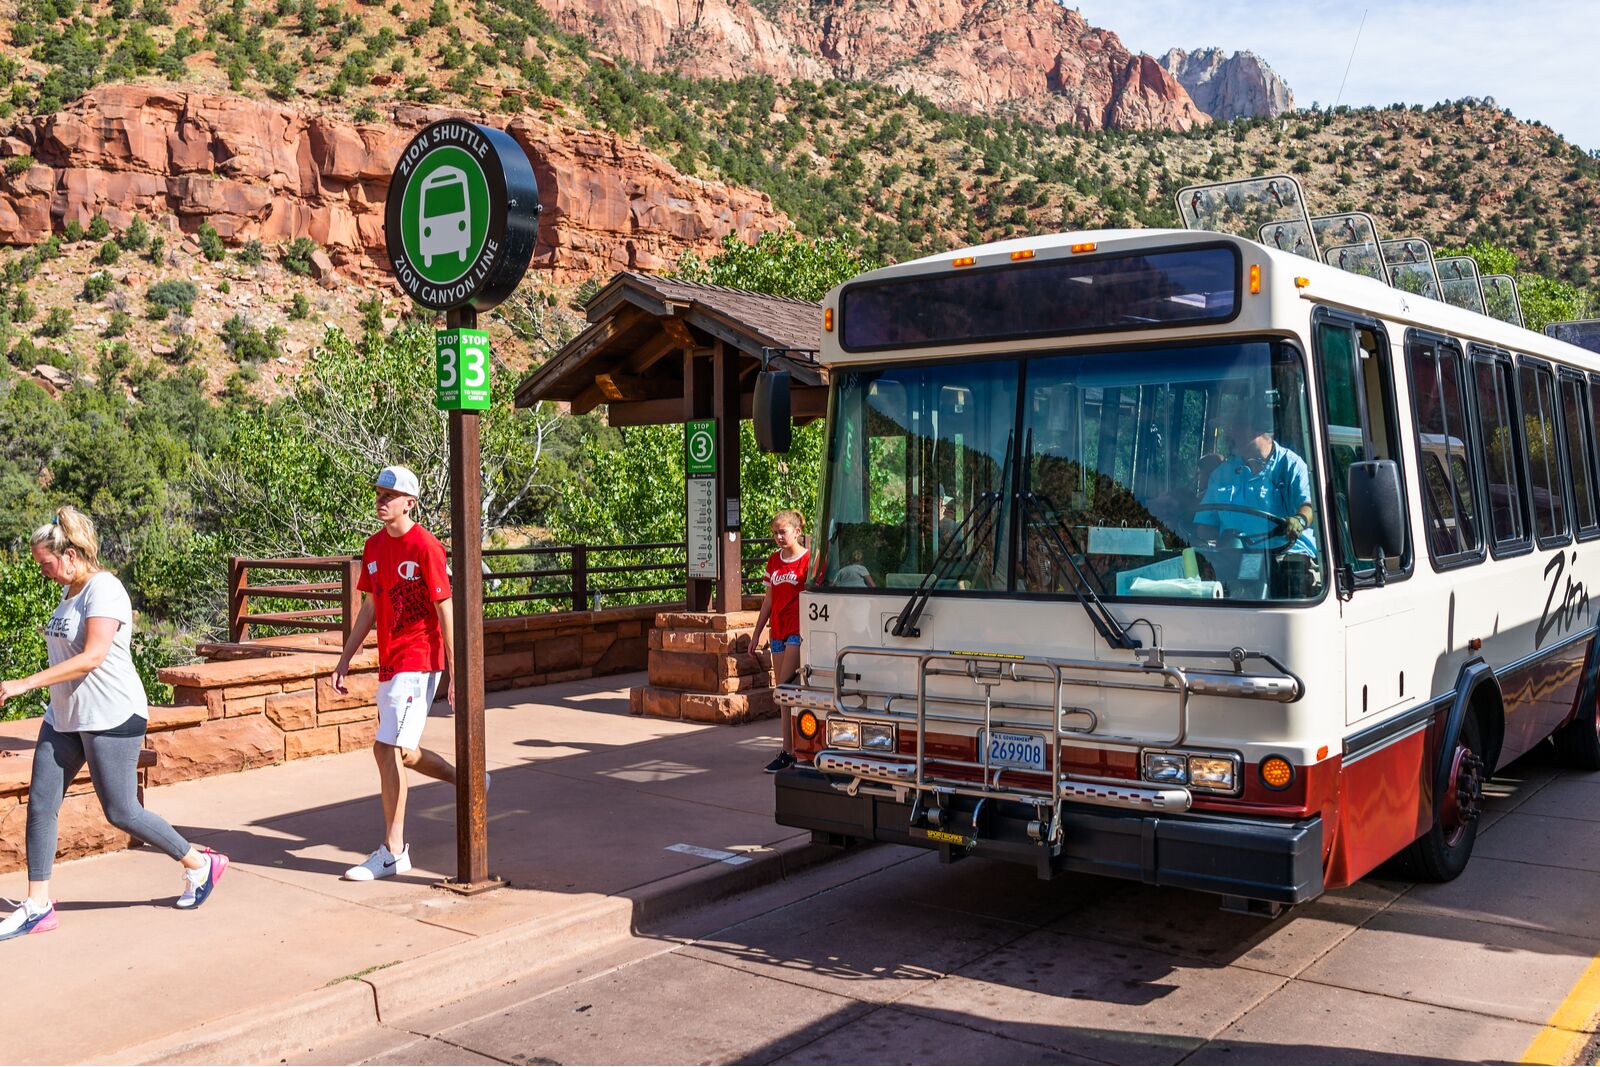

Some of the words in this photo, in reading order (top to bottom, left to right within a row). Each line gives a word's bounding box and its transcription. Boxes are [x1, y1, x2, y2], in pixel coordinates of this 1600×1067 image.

[400, 134, 429, 176] ZION
[432, 125, 489, 159] SHUTTLE
[395, 255, 420, 293] ZION
[421, 276, 475, 304] CANYON
[475, 238, 499, 280] LINE
[437, 335, 459, 346] STOP
[462, 334, 488, 346] STOP
[440, 347, 457, 388] 3
[465, 347, 486, 388] 3
[696, 436, 707, 457] 3
[808, 602, 830, 622] 34
[1002, 735, 1030, 743] GOVERNMENT
[991, 740, 1041, 764] 269908
